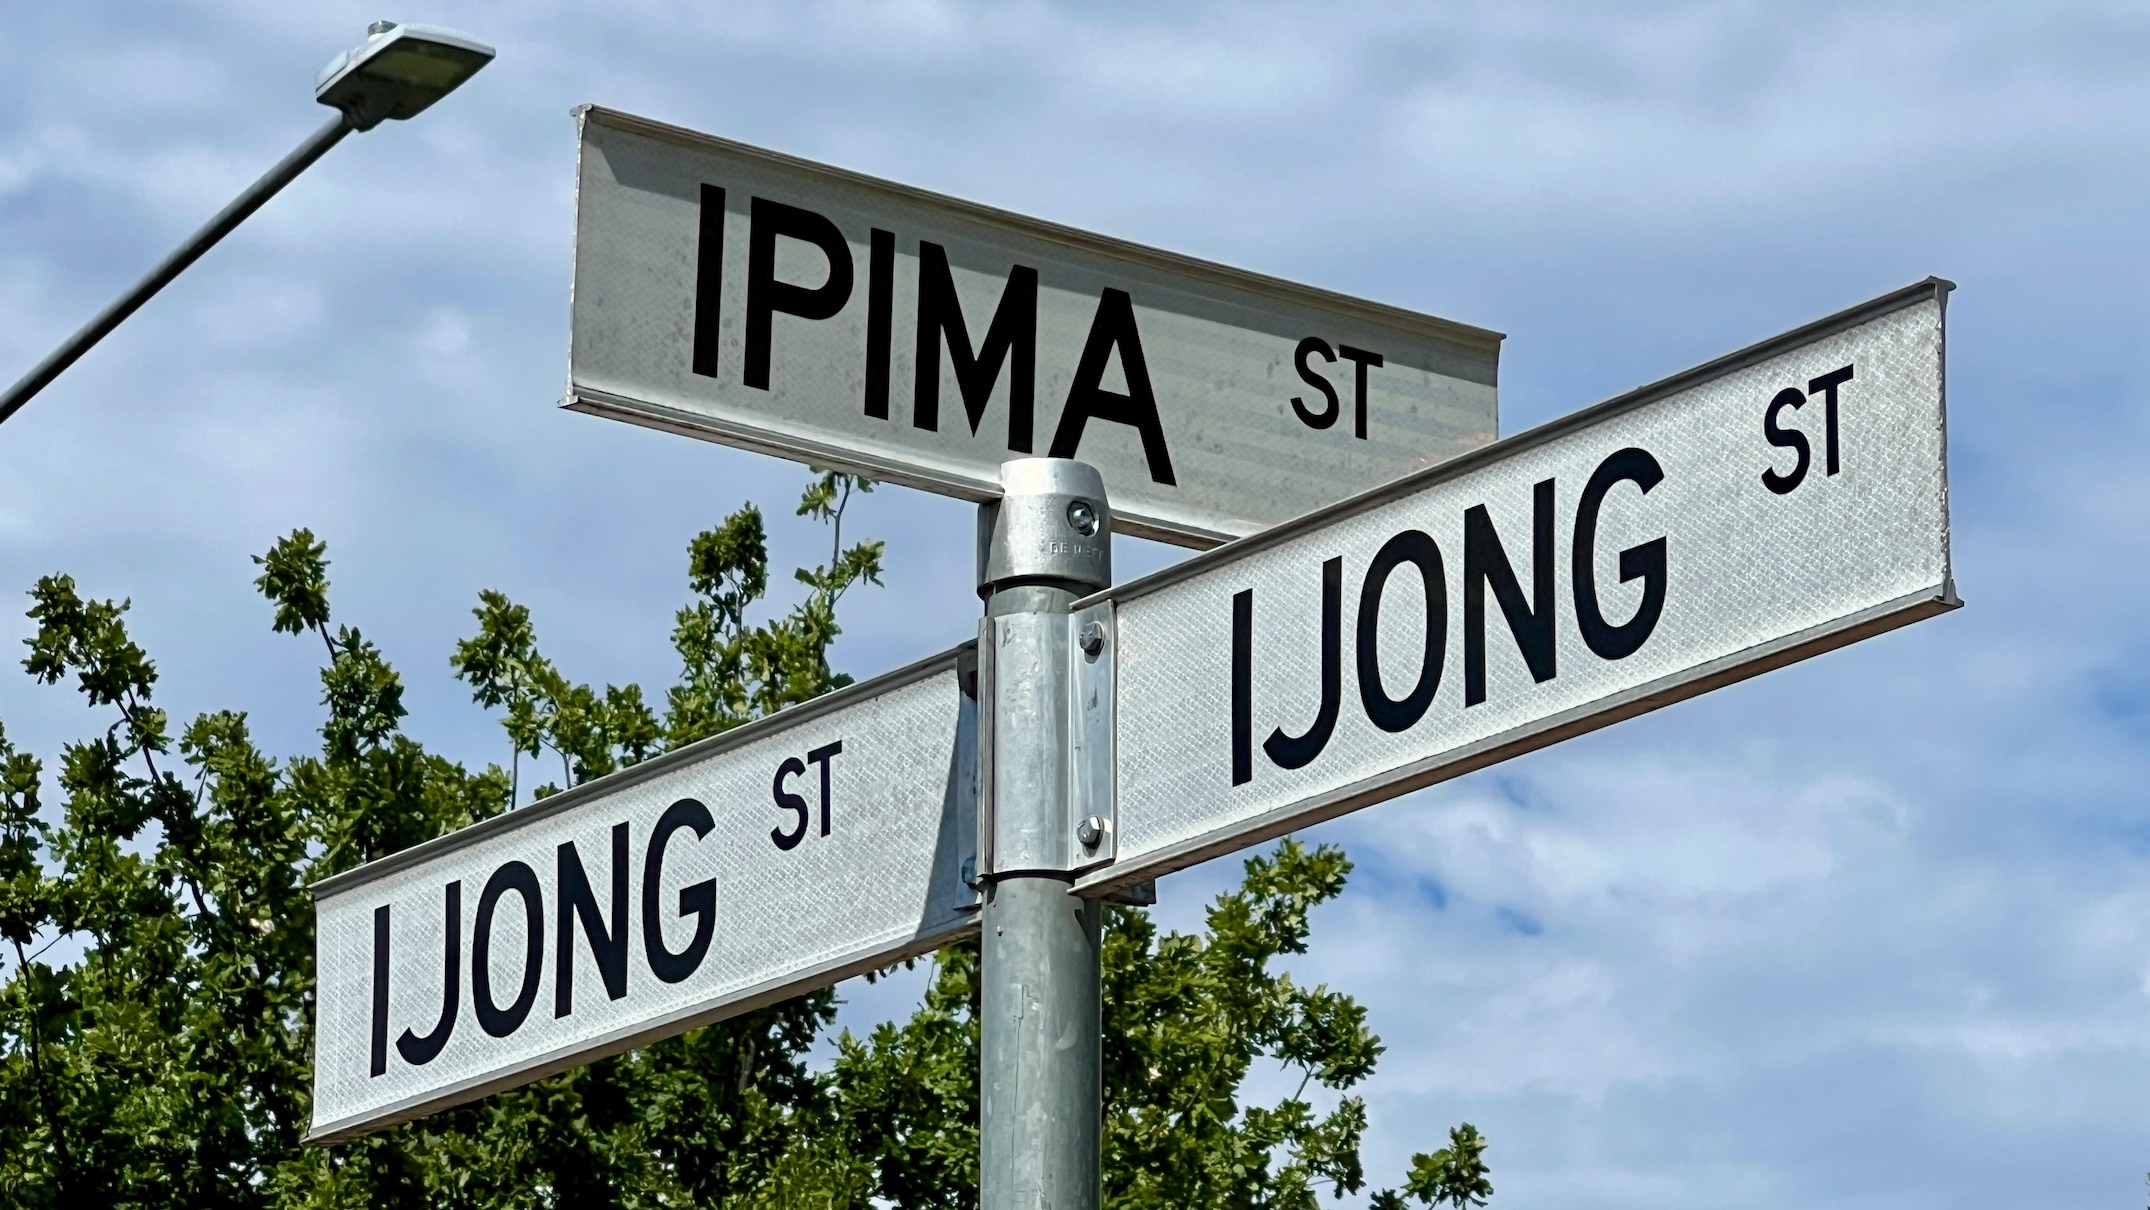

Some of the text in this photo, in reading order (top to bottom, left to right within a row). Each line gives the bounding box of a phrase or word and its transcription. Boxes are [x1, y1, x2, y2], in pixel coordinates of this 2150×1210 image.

[693, 182, 1383, 486] IPIMA ST
[1232, 364, 1853, 787] IJONG ST
[371, 740, 842, 1078] IJONG ST
